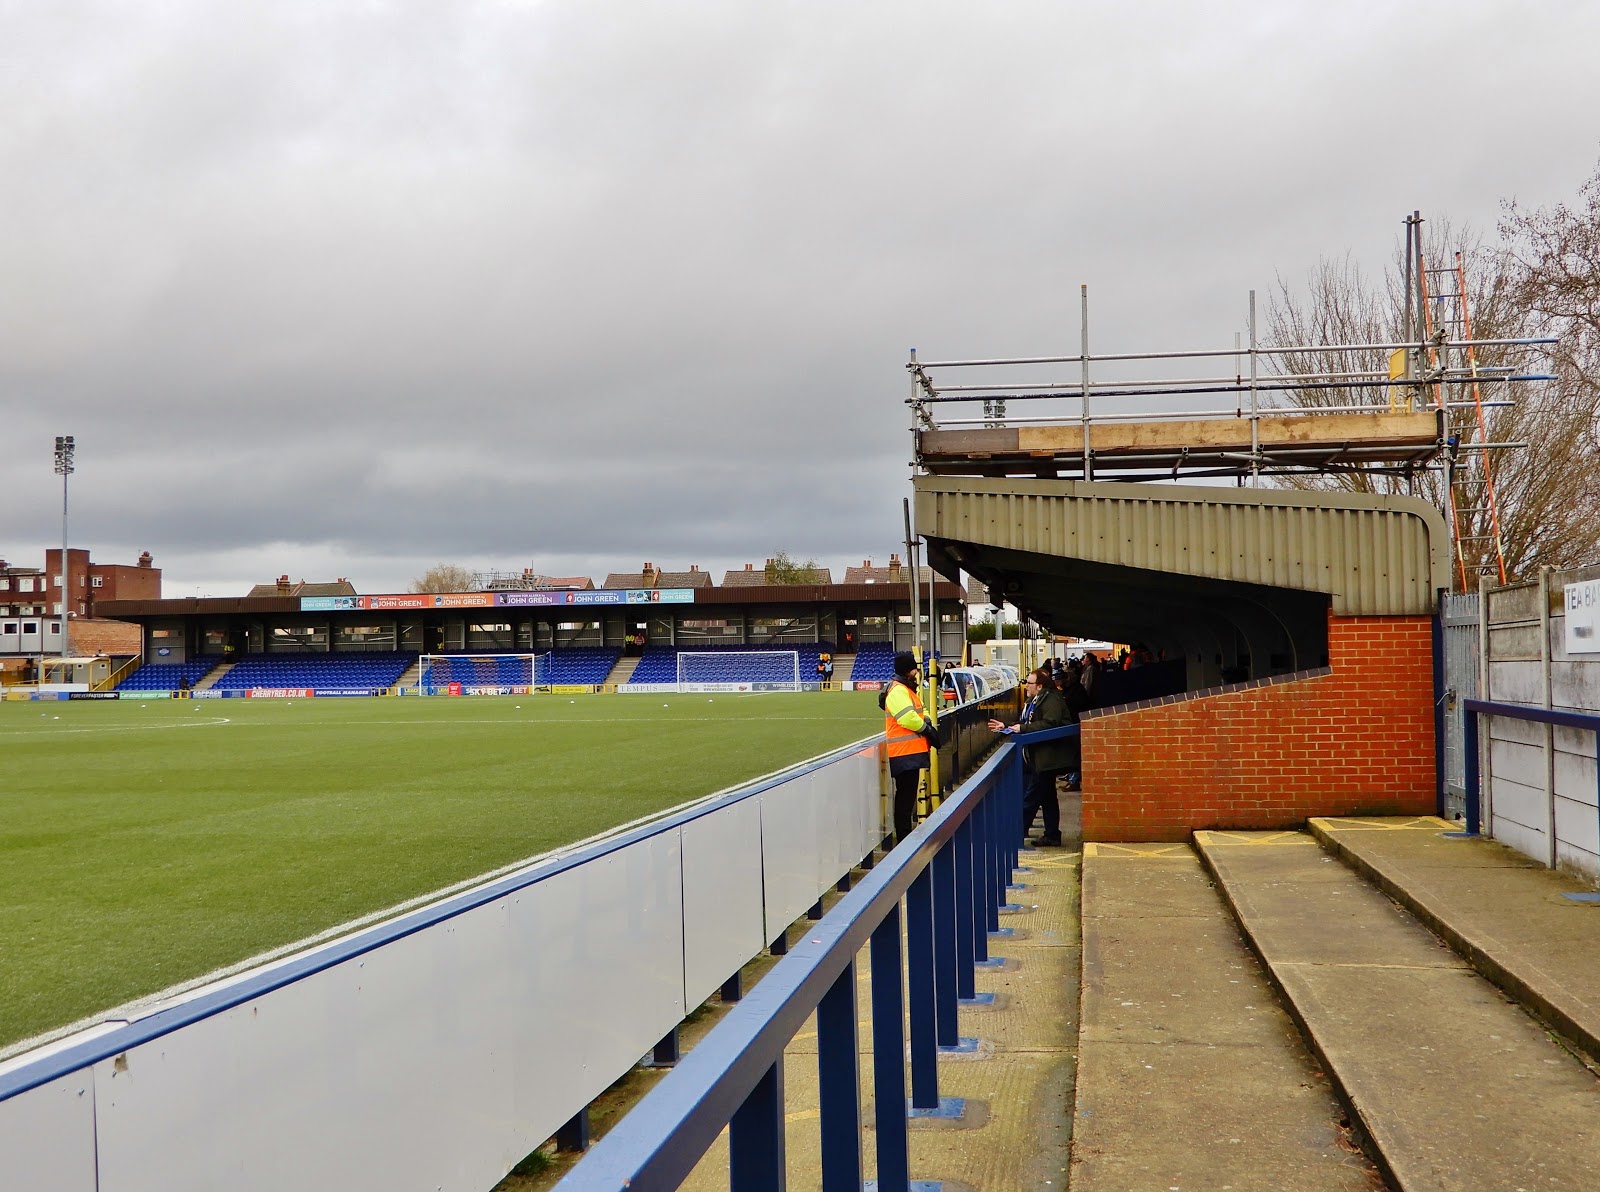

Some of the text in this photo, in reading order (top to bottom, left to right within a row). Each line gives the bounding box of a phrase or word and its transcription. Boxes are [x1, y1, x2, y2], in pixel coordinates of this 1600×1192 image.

[1565, 587, 1582, 610] TEA
[251, 689, 307, 698] CHERRYRED.CO.UK
[486, 687, 503, 696] BET
